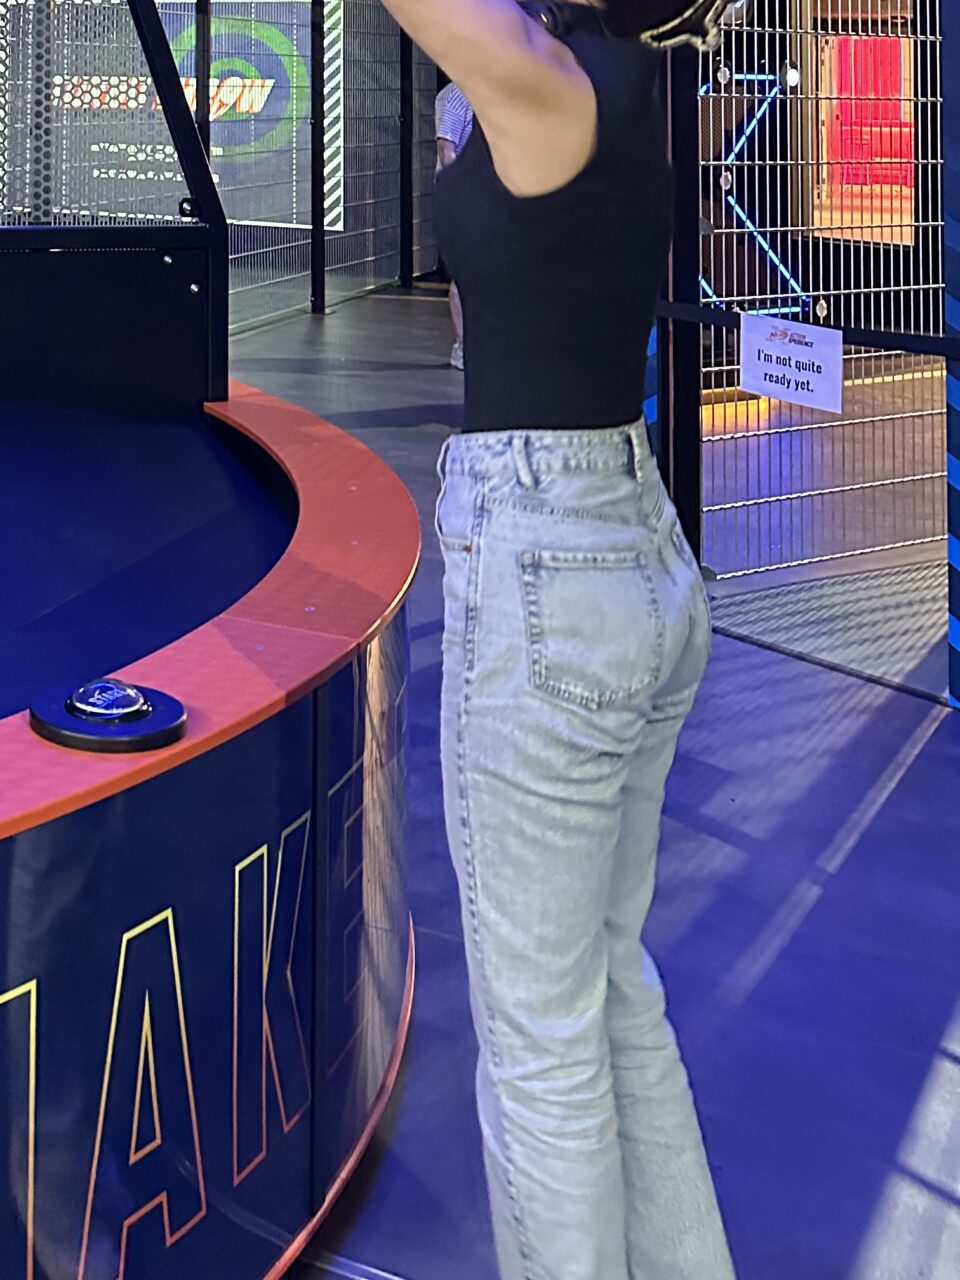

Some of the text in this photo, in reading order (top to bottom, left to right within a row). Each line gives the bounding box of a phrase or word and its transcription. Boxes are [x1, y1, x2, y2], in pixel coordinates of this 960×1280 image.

[757, 349, 822, 374] I'm not quite
[763, 372, 814, 393] ready yet.
